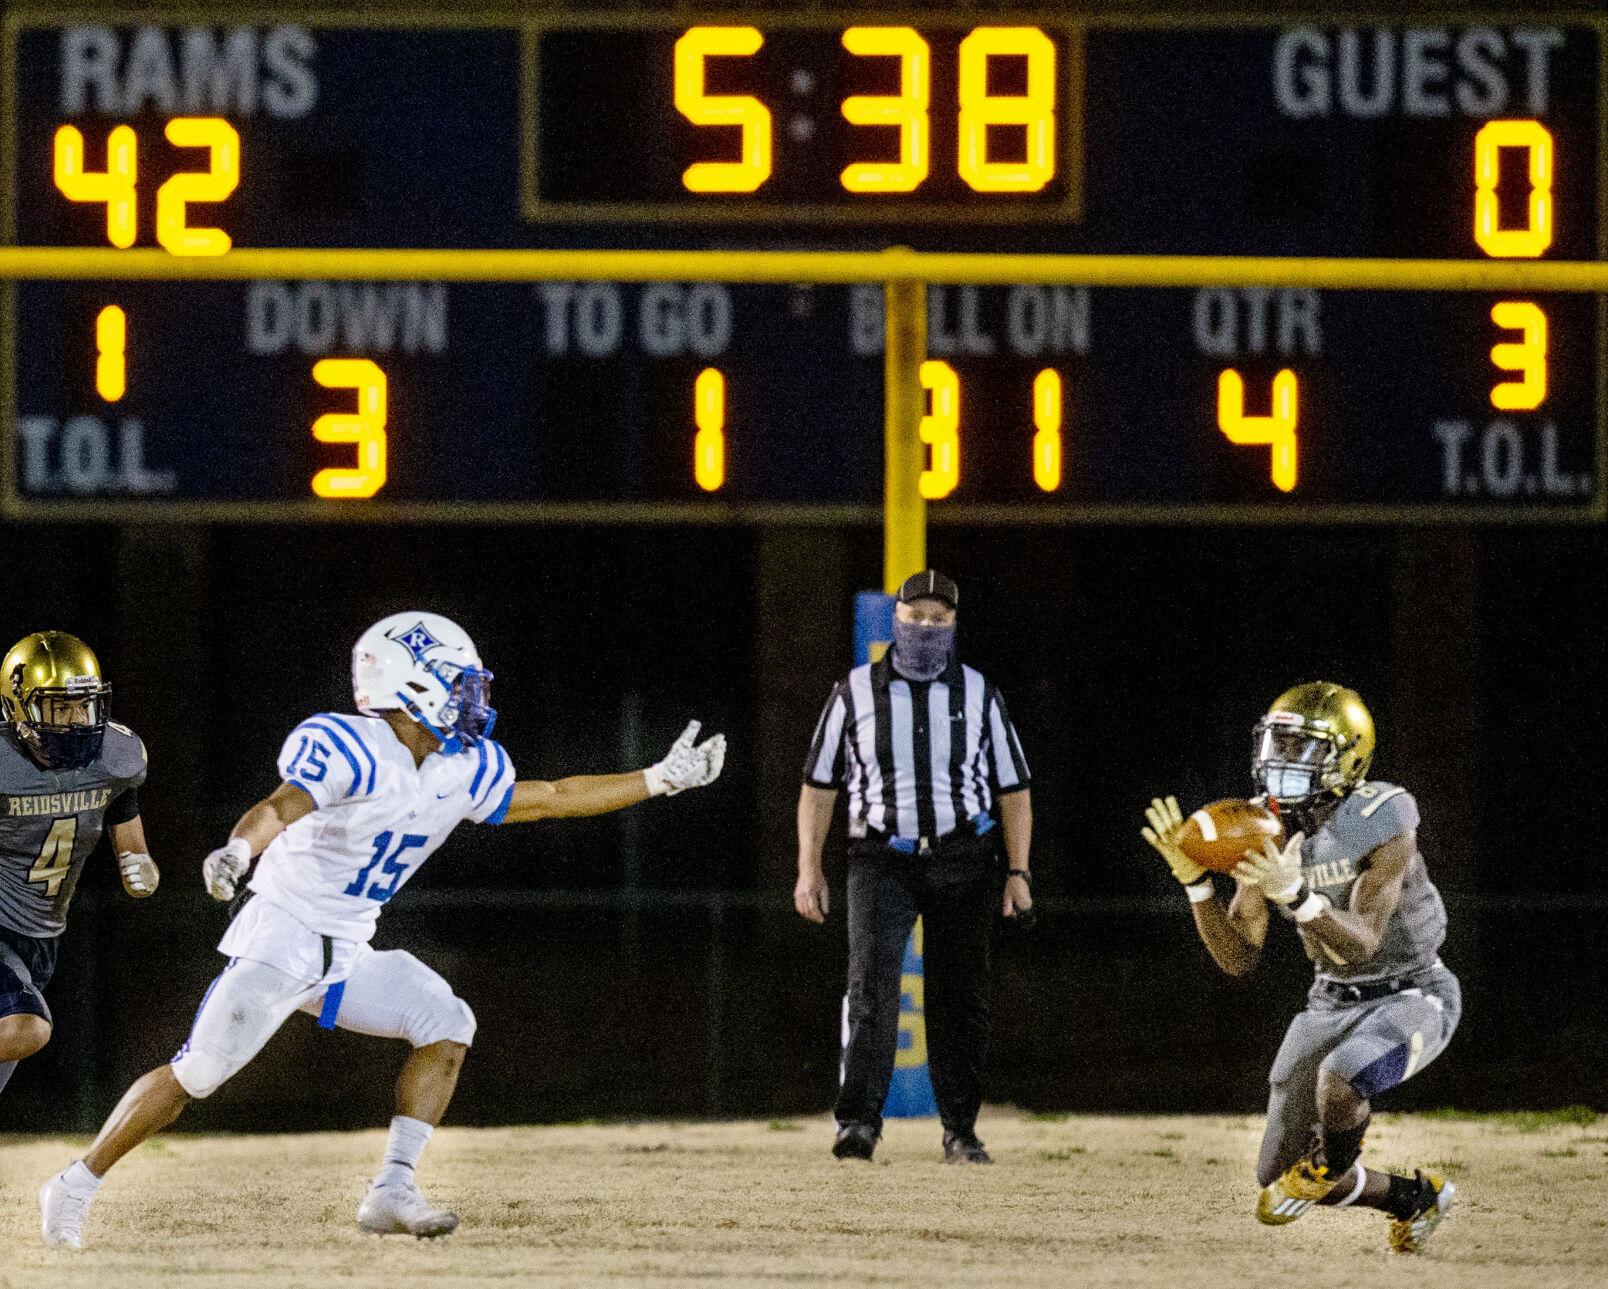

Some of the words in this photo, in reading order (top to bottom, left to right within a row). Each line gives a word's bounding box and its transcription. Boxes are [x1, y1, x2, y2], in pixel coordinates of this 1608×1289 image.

[61, 25, 318, 117] RAMS
[674, 26, 1056, 193] 5:38
[1272, 28, 1566, 116] GUEST
[54, 117, 240, 256] 42
[1474, 119, 1553, 258] 0
[95, 304, 126, 402] 1
[247, 282, 449, 355] DOWN
[538, 281, 623, 357] TO
[637, 281, 733, 357] GO
[849, 283, 996, 357] BLL
[1006, 285, 1092, 356] ON
[1192, 287, 1323, 357] QTR
[1489, 301, 1548, 411] 3
[312, 358, 387, 499] 3
[694, 367, 725, 492] 1
[1218, 368, 1298, 493] 4
[1431, 418, 1594, 496] T.O.L.
[7, 788, 112, 817] REIDSVILLE
[286, 735, 332, 784] 15
[27, 817, 77, 896] 4
[343, 830, 430, 903] 15
